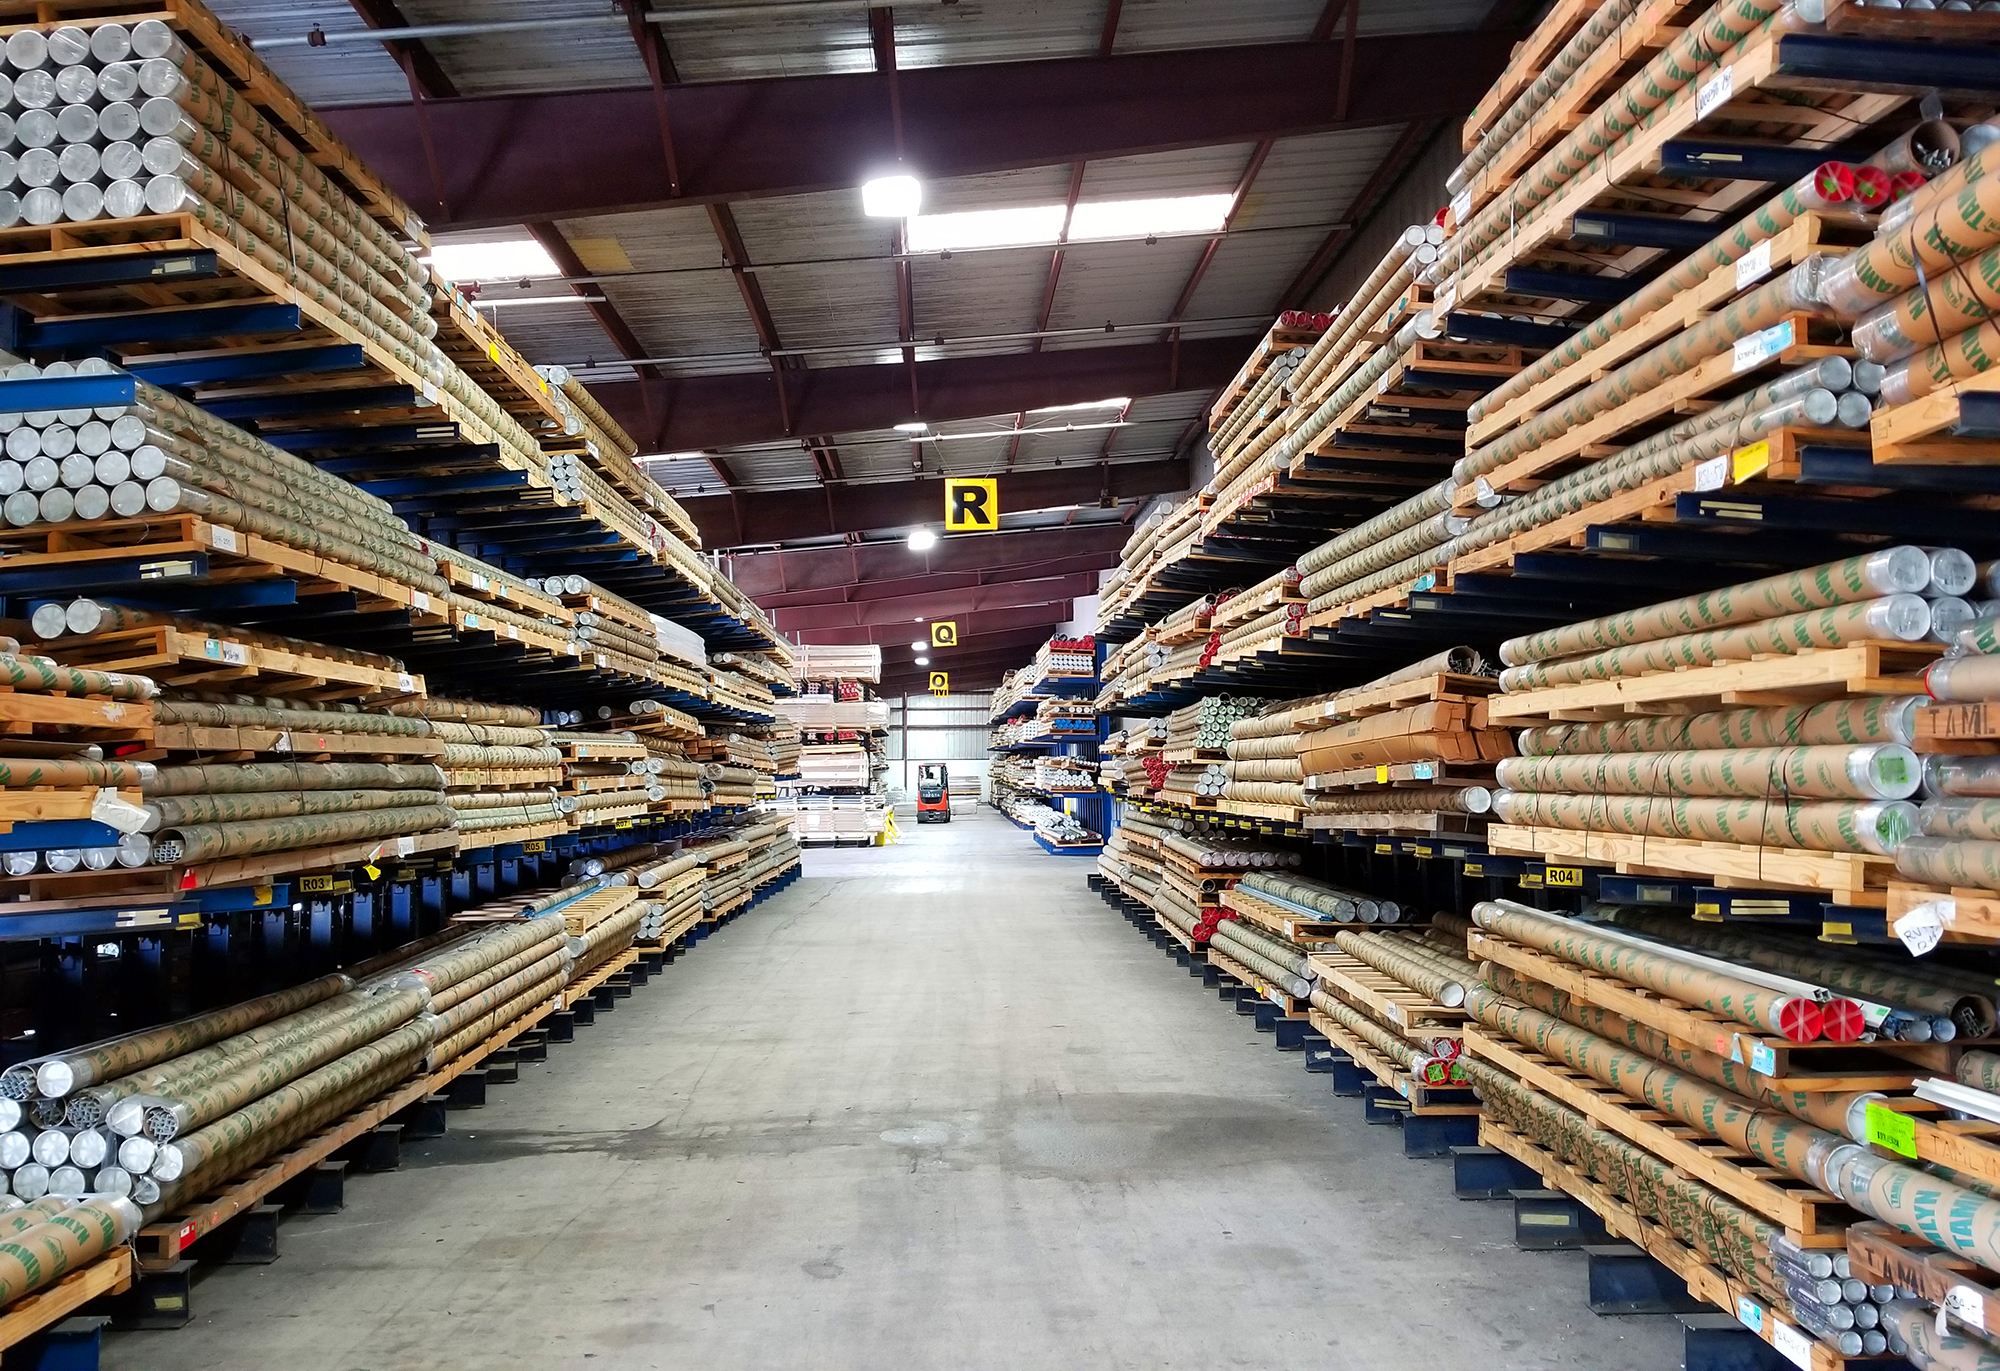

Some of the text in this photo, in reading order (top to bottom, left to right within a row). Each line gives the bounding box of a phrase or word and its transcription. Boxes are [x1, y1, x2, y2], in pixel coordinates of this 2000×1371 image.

[952, 485, 991, 525] R
[934, 625, 954, 645] Q
[932, 674, 946, 687] O
[525, 843, 540, 852] R05
[1550, 869, 1574, 883] R04
[303, 878, 325, 891] R03
